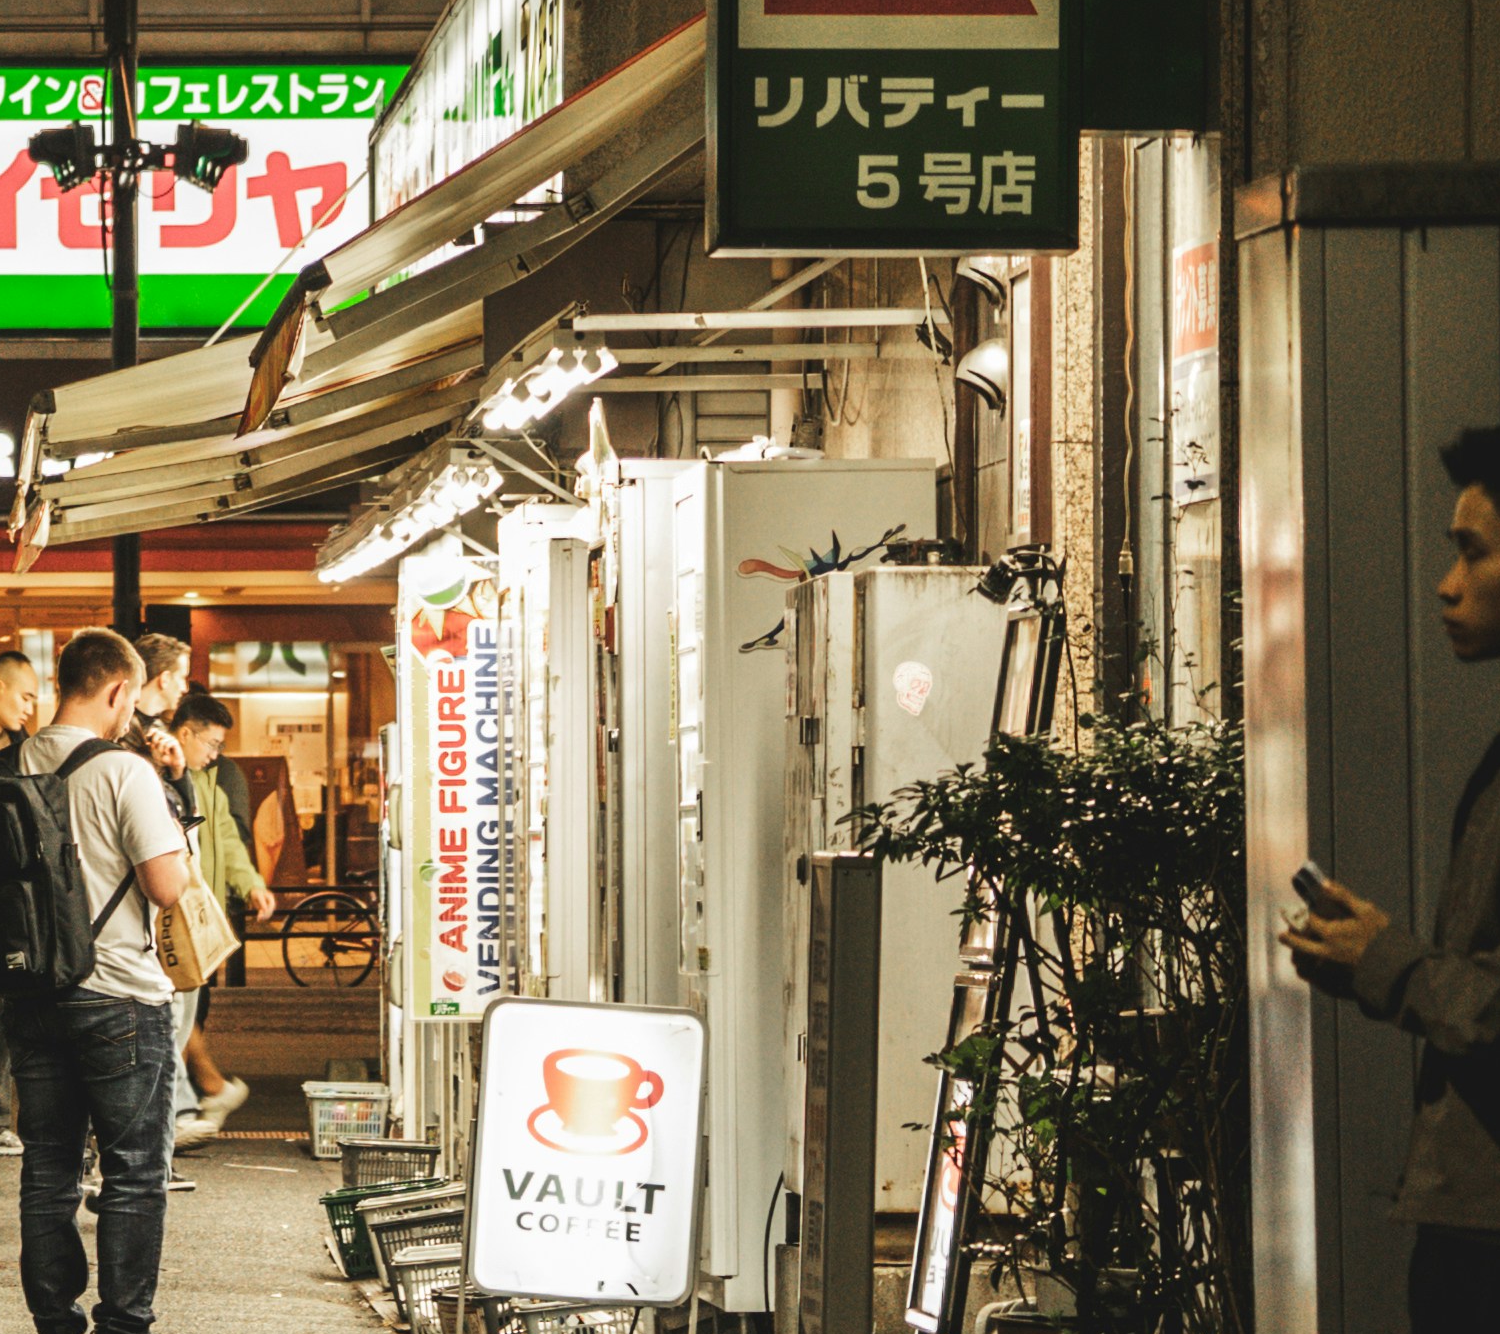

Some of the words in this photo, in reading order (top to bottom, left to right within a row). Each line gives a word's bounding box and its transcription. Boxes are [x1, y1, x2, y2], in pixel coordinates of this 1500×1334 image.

[754, 74, 1046, 130] リバティー
[855, 150, 1037, 216] 5号店
[438, 668, 467, 814] FIGURE
[475, 625, 500, 806] MACHINE
[439, 827, 468, 953] ANIME
[476, 819, 502, 996] VENDING
[503, 1168, 665, 1215] VAULT
